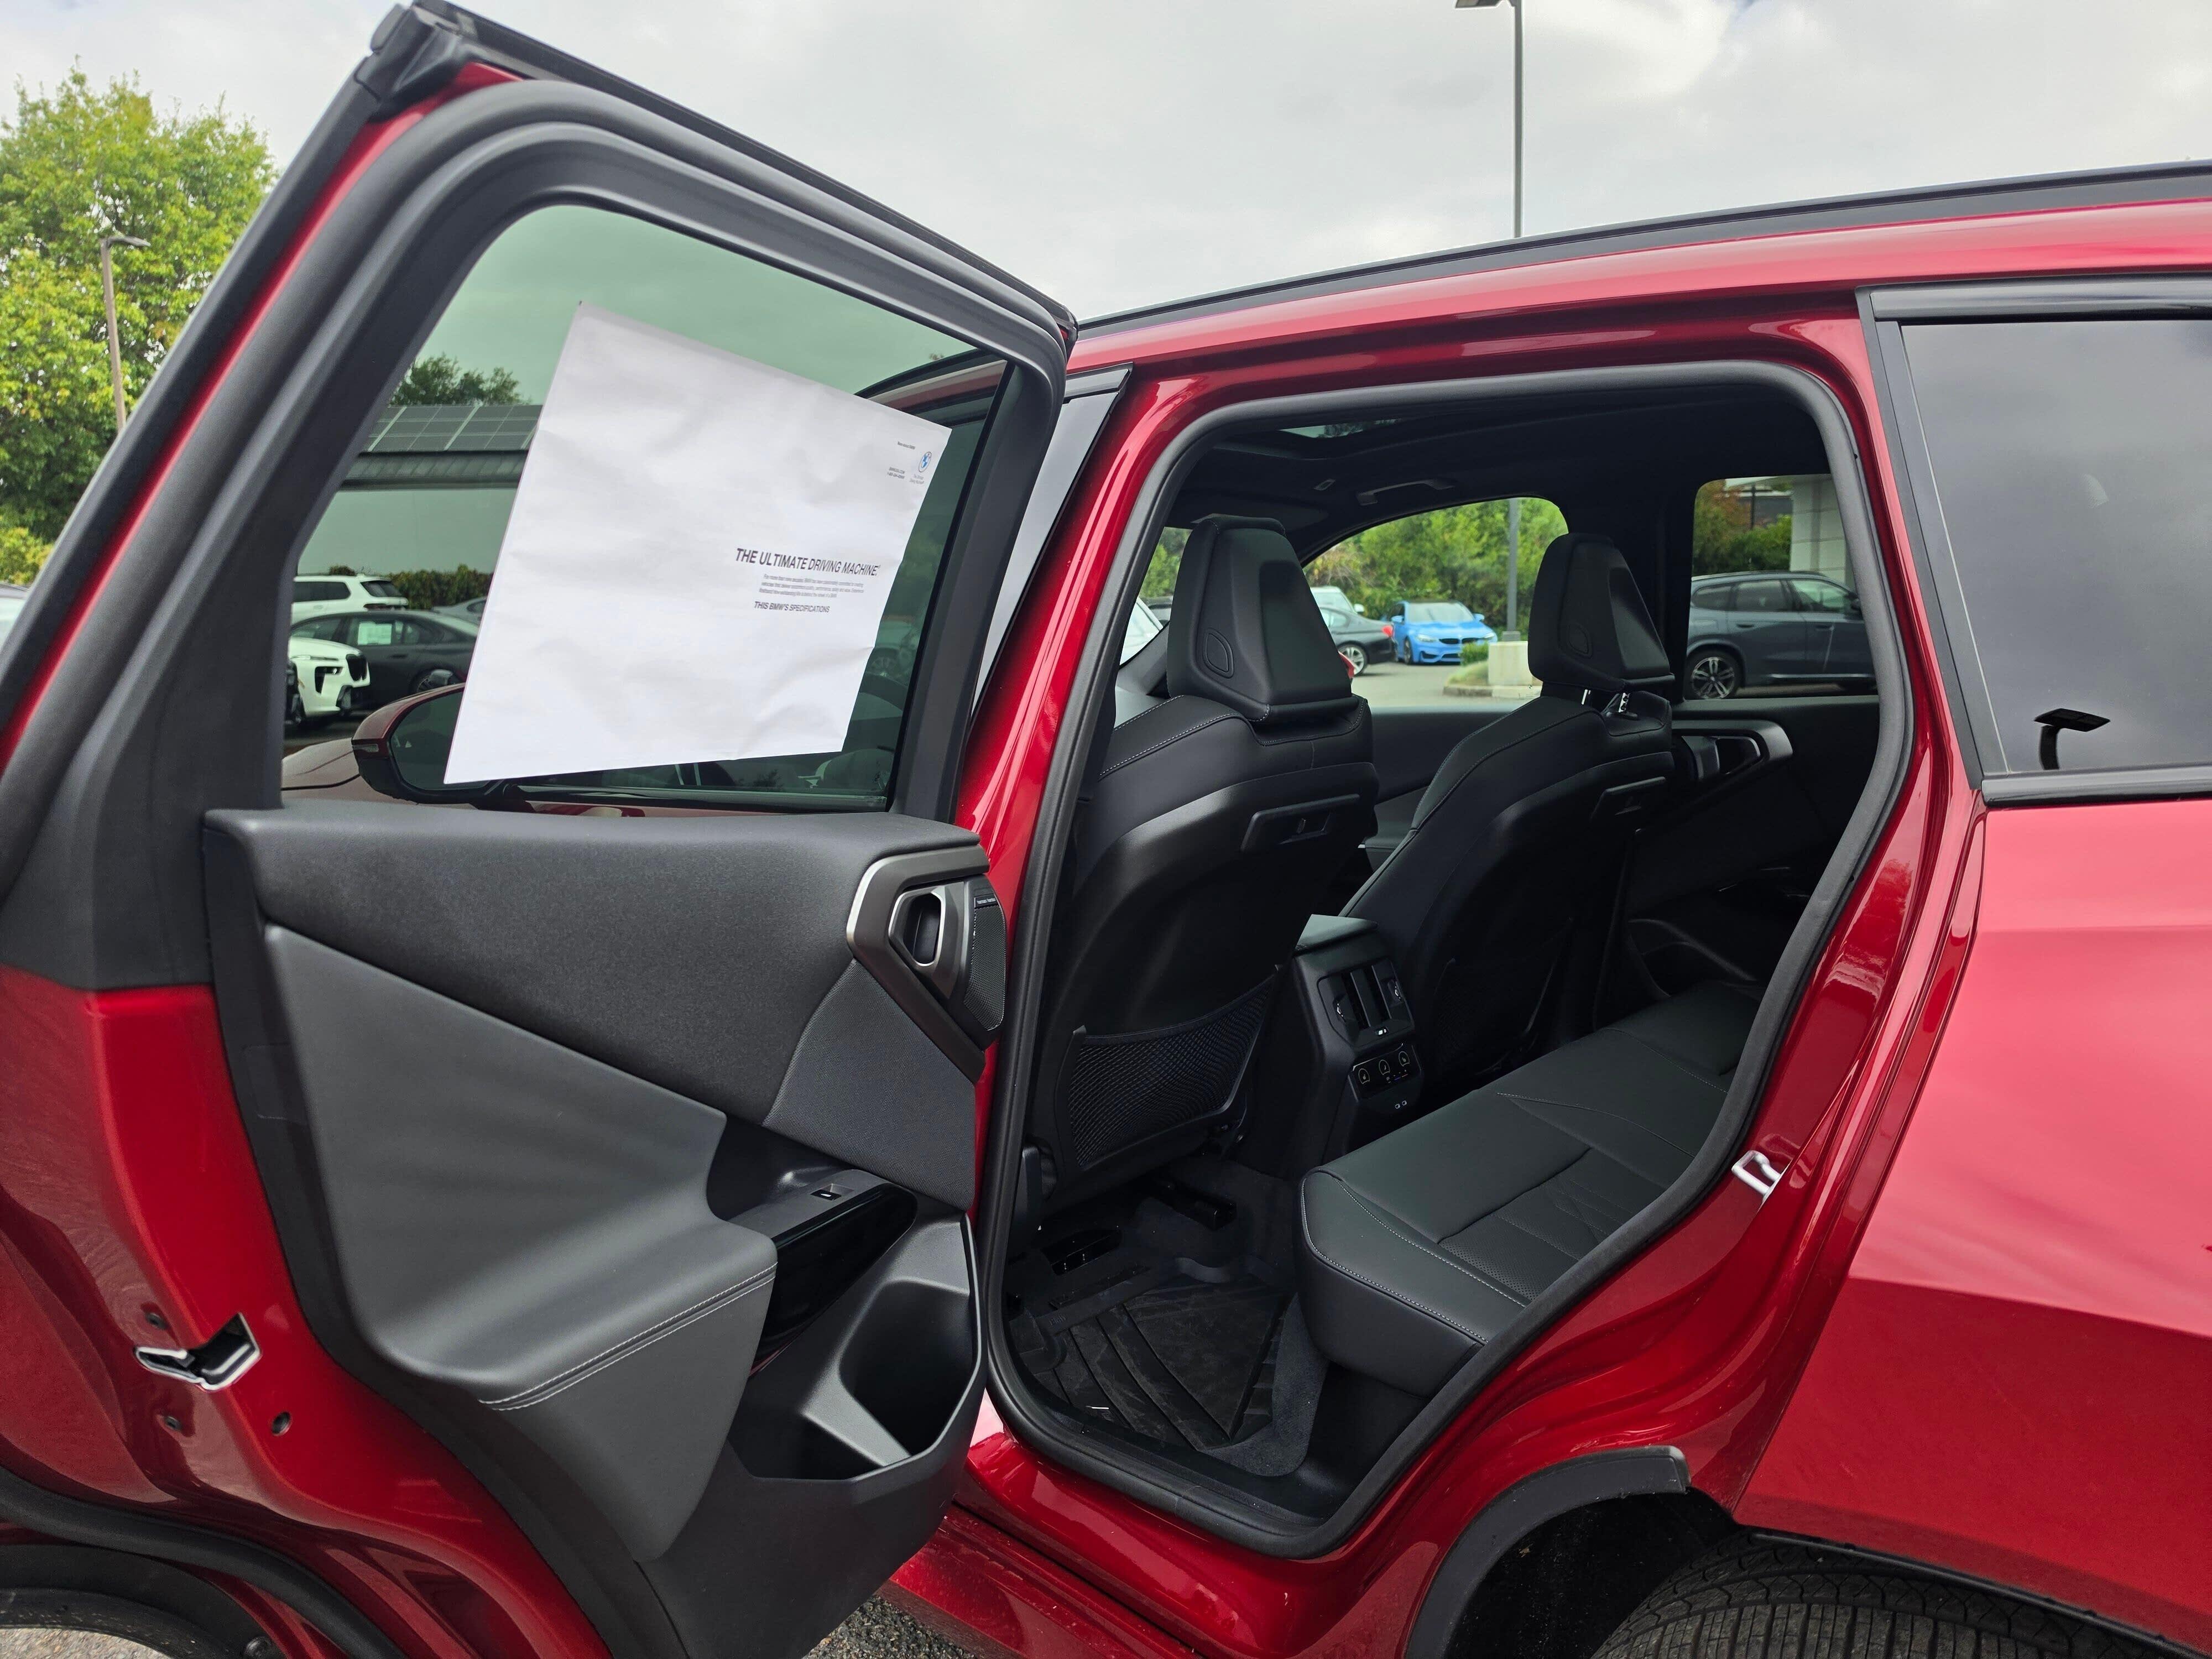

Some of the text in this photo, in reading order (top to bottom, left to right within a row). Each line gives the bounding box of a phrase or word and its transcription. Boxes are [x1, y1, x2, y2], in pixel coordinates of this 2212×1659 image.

[735, 547, 759, 564] THE
[759, 551, 808, 570] ULTIMATE
[808, 559, 842, 573] DRIVING
[754, 601, 831, 613] THIS BMW'S SPECIFICATIONS
